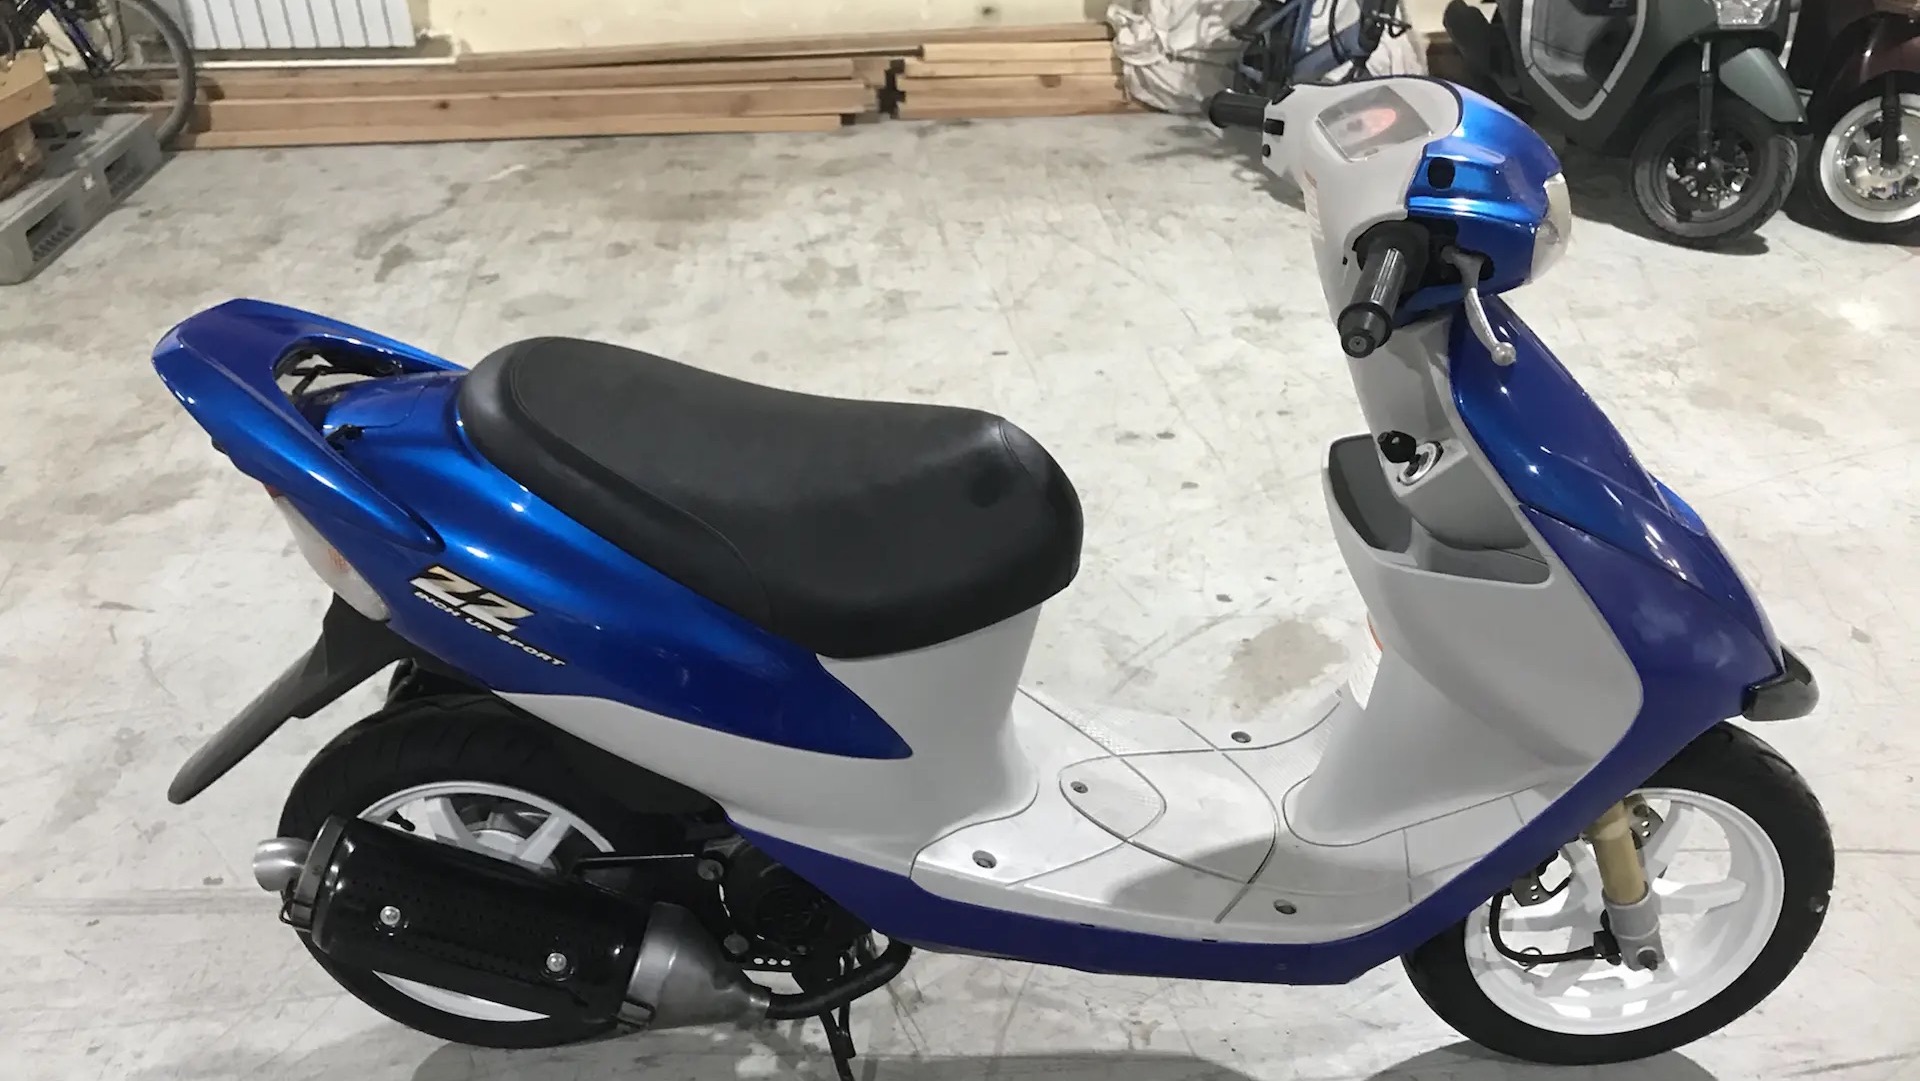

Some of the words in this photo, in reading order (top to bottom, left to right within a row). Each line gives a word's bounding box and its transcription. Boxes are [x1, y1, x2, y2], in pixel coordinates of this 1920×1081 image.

[409, 565, 535, 633] ZZ
[414, 591, 461, 617] INCH
[465, 617, 493, 633] UP
[497, 633, 566, 666] SPORT
